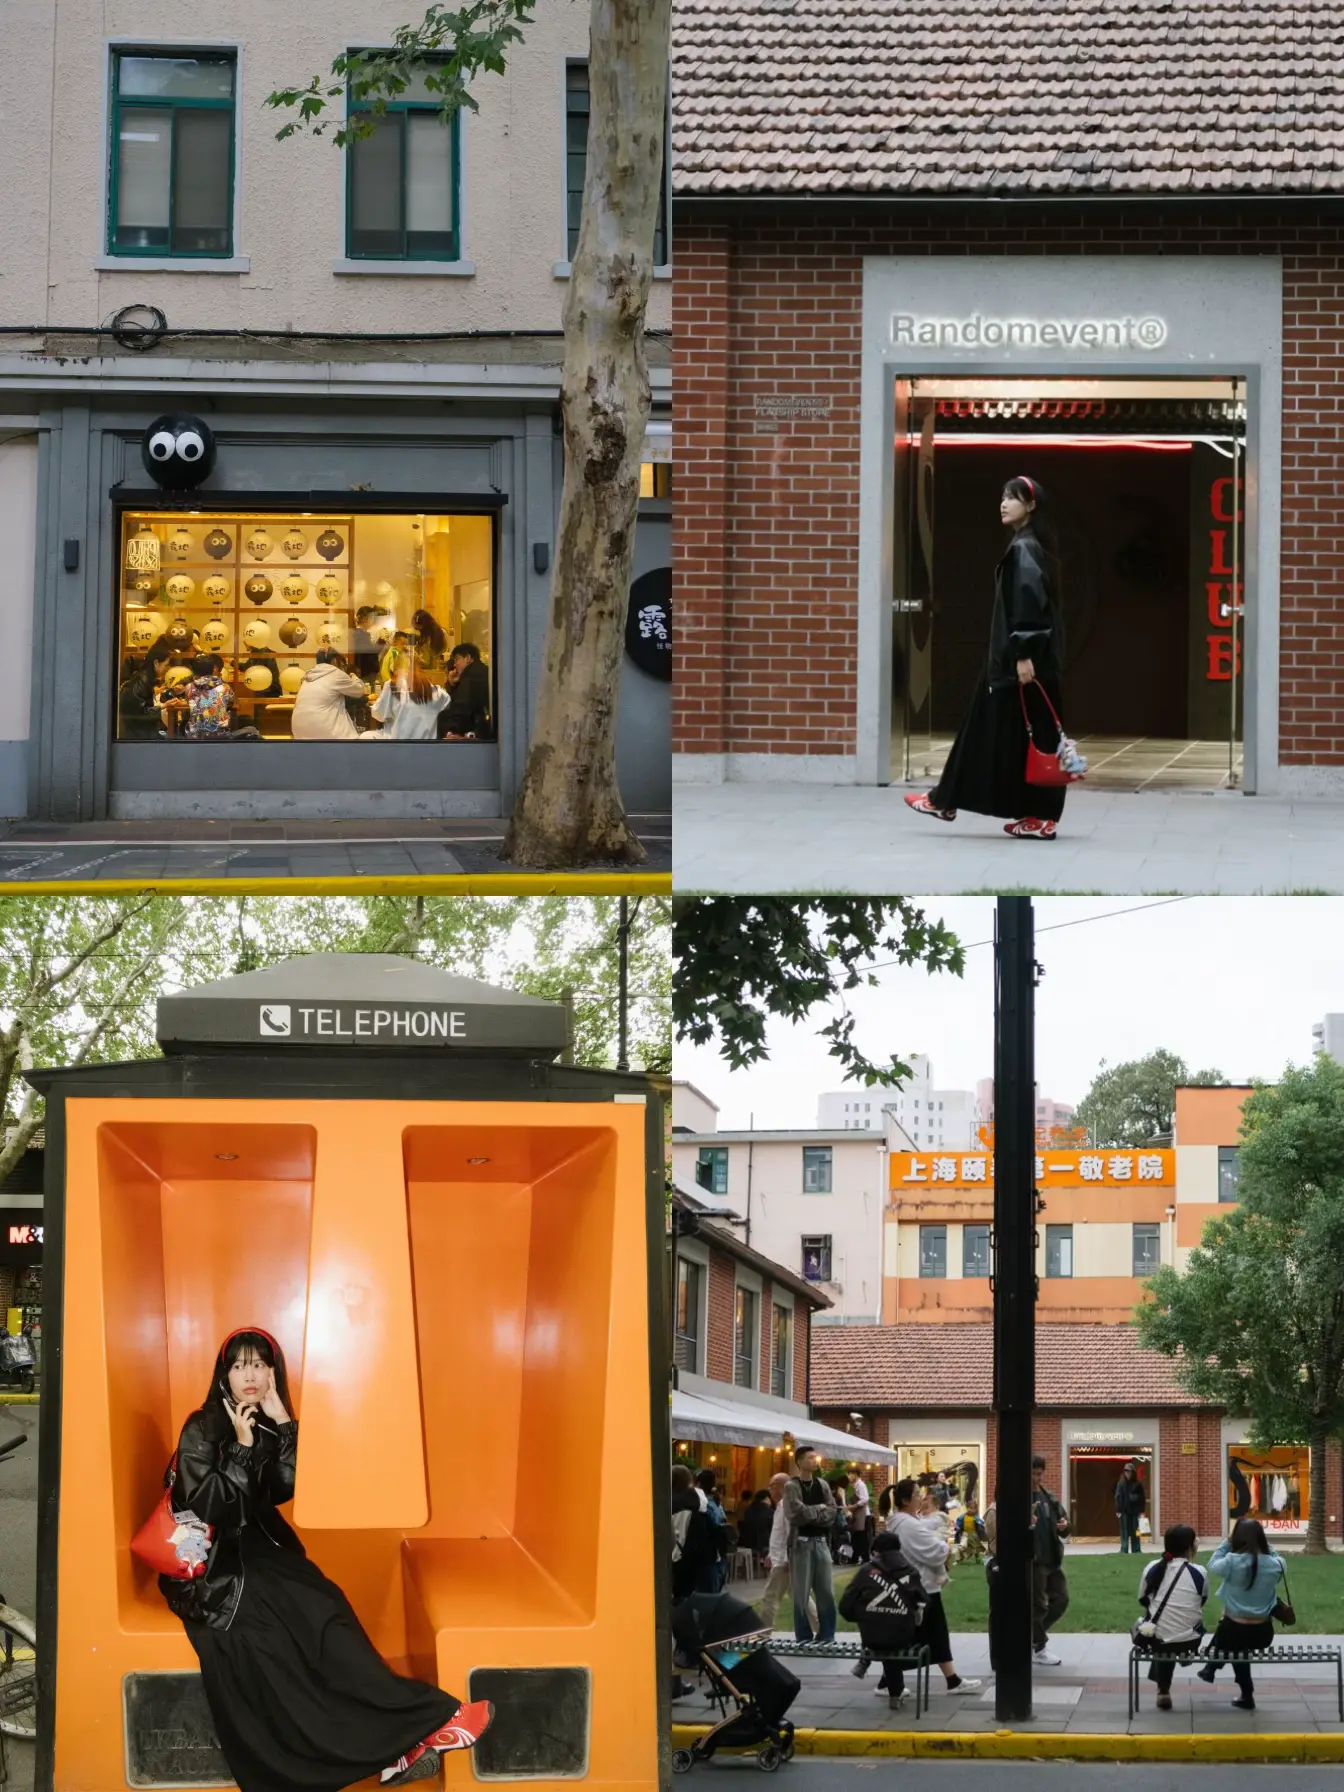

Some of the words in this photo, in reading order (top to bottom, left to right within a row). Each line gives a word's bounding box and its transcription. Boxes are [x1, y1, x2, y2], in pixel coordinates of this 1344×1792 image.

[1204, 477, 1244, 681] CLUB
[298, 1008, 467, 1038] TELEPHONE
[902, 1155, 1164, 1182] 上海颐一敬老院
